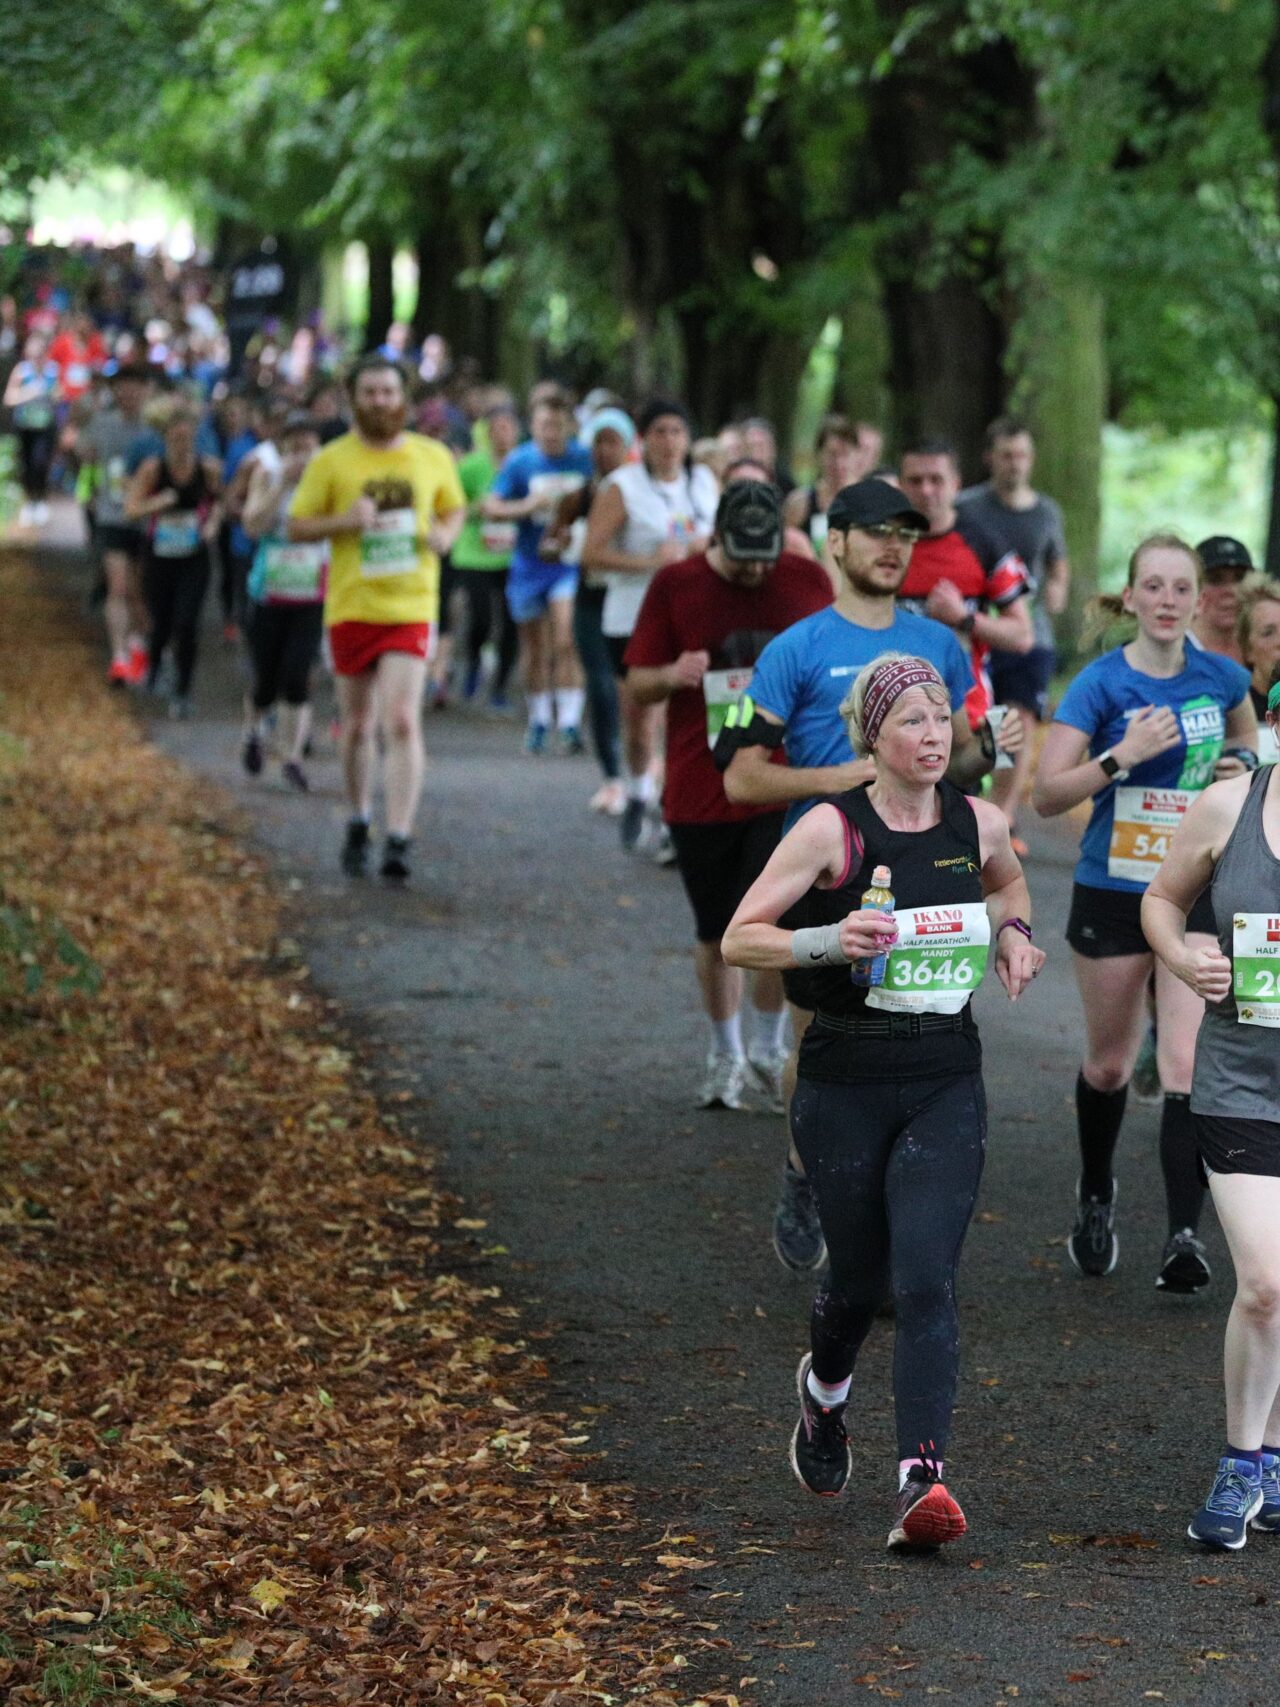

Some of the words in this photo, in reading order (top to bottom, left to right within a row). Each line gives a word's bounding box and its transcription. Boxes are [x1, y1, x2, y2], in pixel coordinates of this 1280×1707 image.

[886, 683, 902, 703] DID
[904, 673, 927, 684] YOU
[913, 909, 963, 924] IKANO
[926, 924, 953, 933] BANK
[903, 939, 924, 947] HALF
[925, 936, 970, 946] MARATHON
[920, 949, 955, 957] MANDY
[893, 958, 973, 986] 3646
